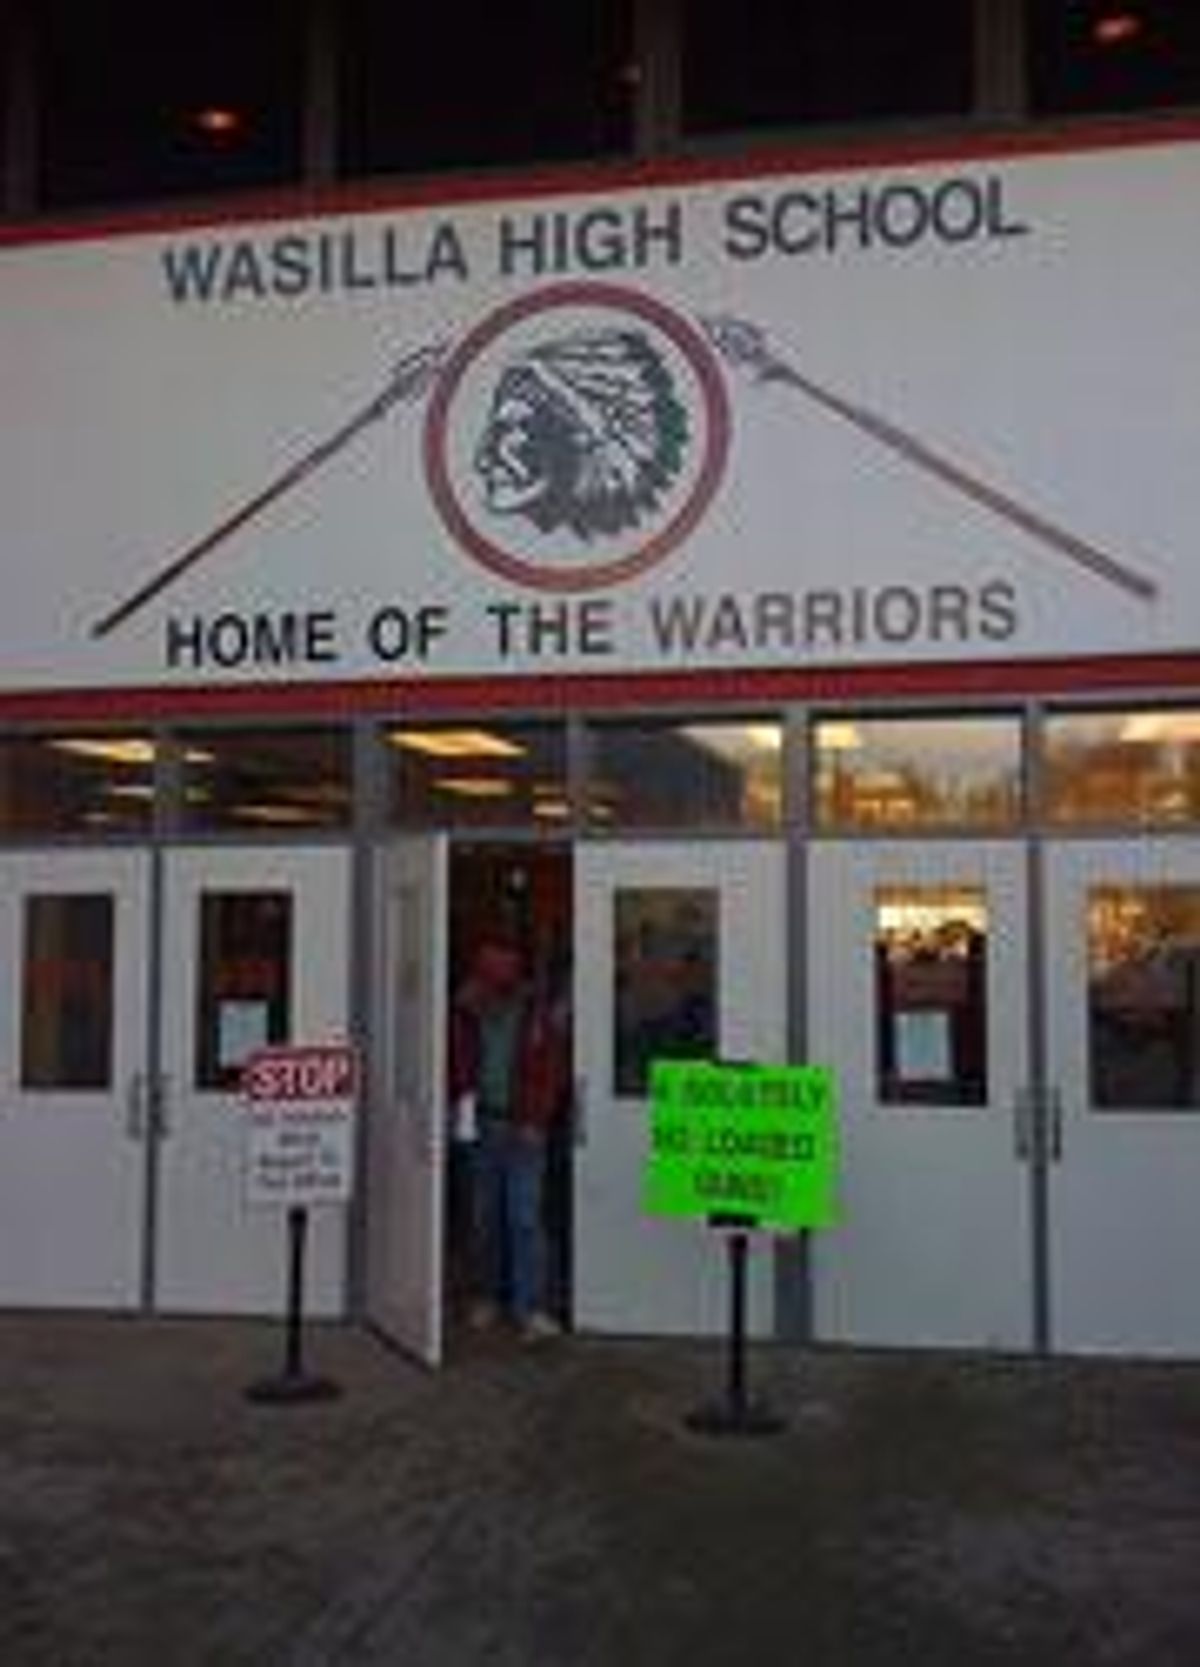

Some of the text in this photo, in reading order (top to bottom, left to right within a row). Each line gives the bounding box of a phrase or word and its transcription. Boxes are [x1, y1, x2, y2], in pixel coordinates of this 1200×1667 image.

[163, 175, 1031, 301] WASILLA HIGH SCHOOL
[166, 580, 1018, 667] HOME OF THE WARRIORS
[251, 1056, 349, 1096] STOP
